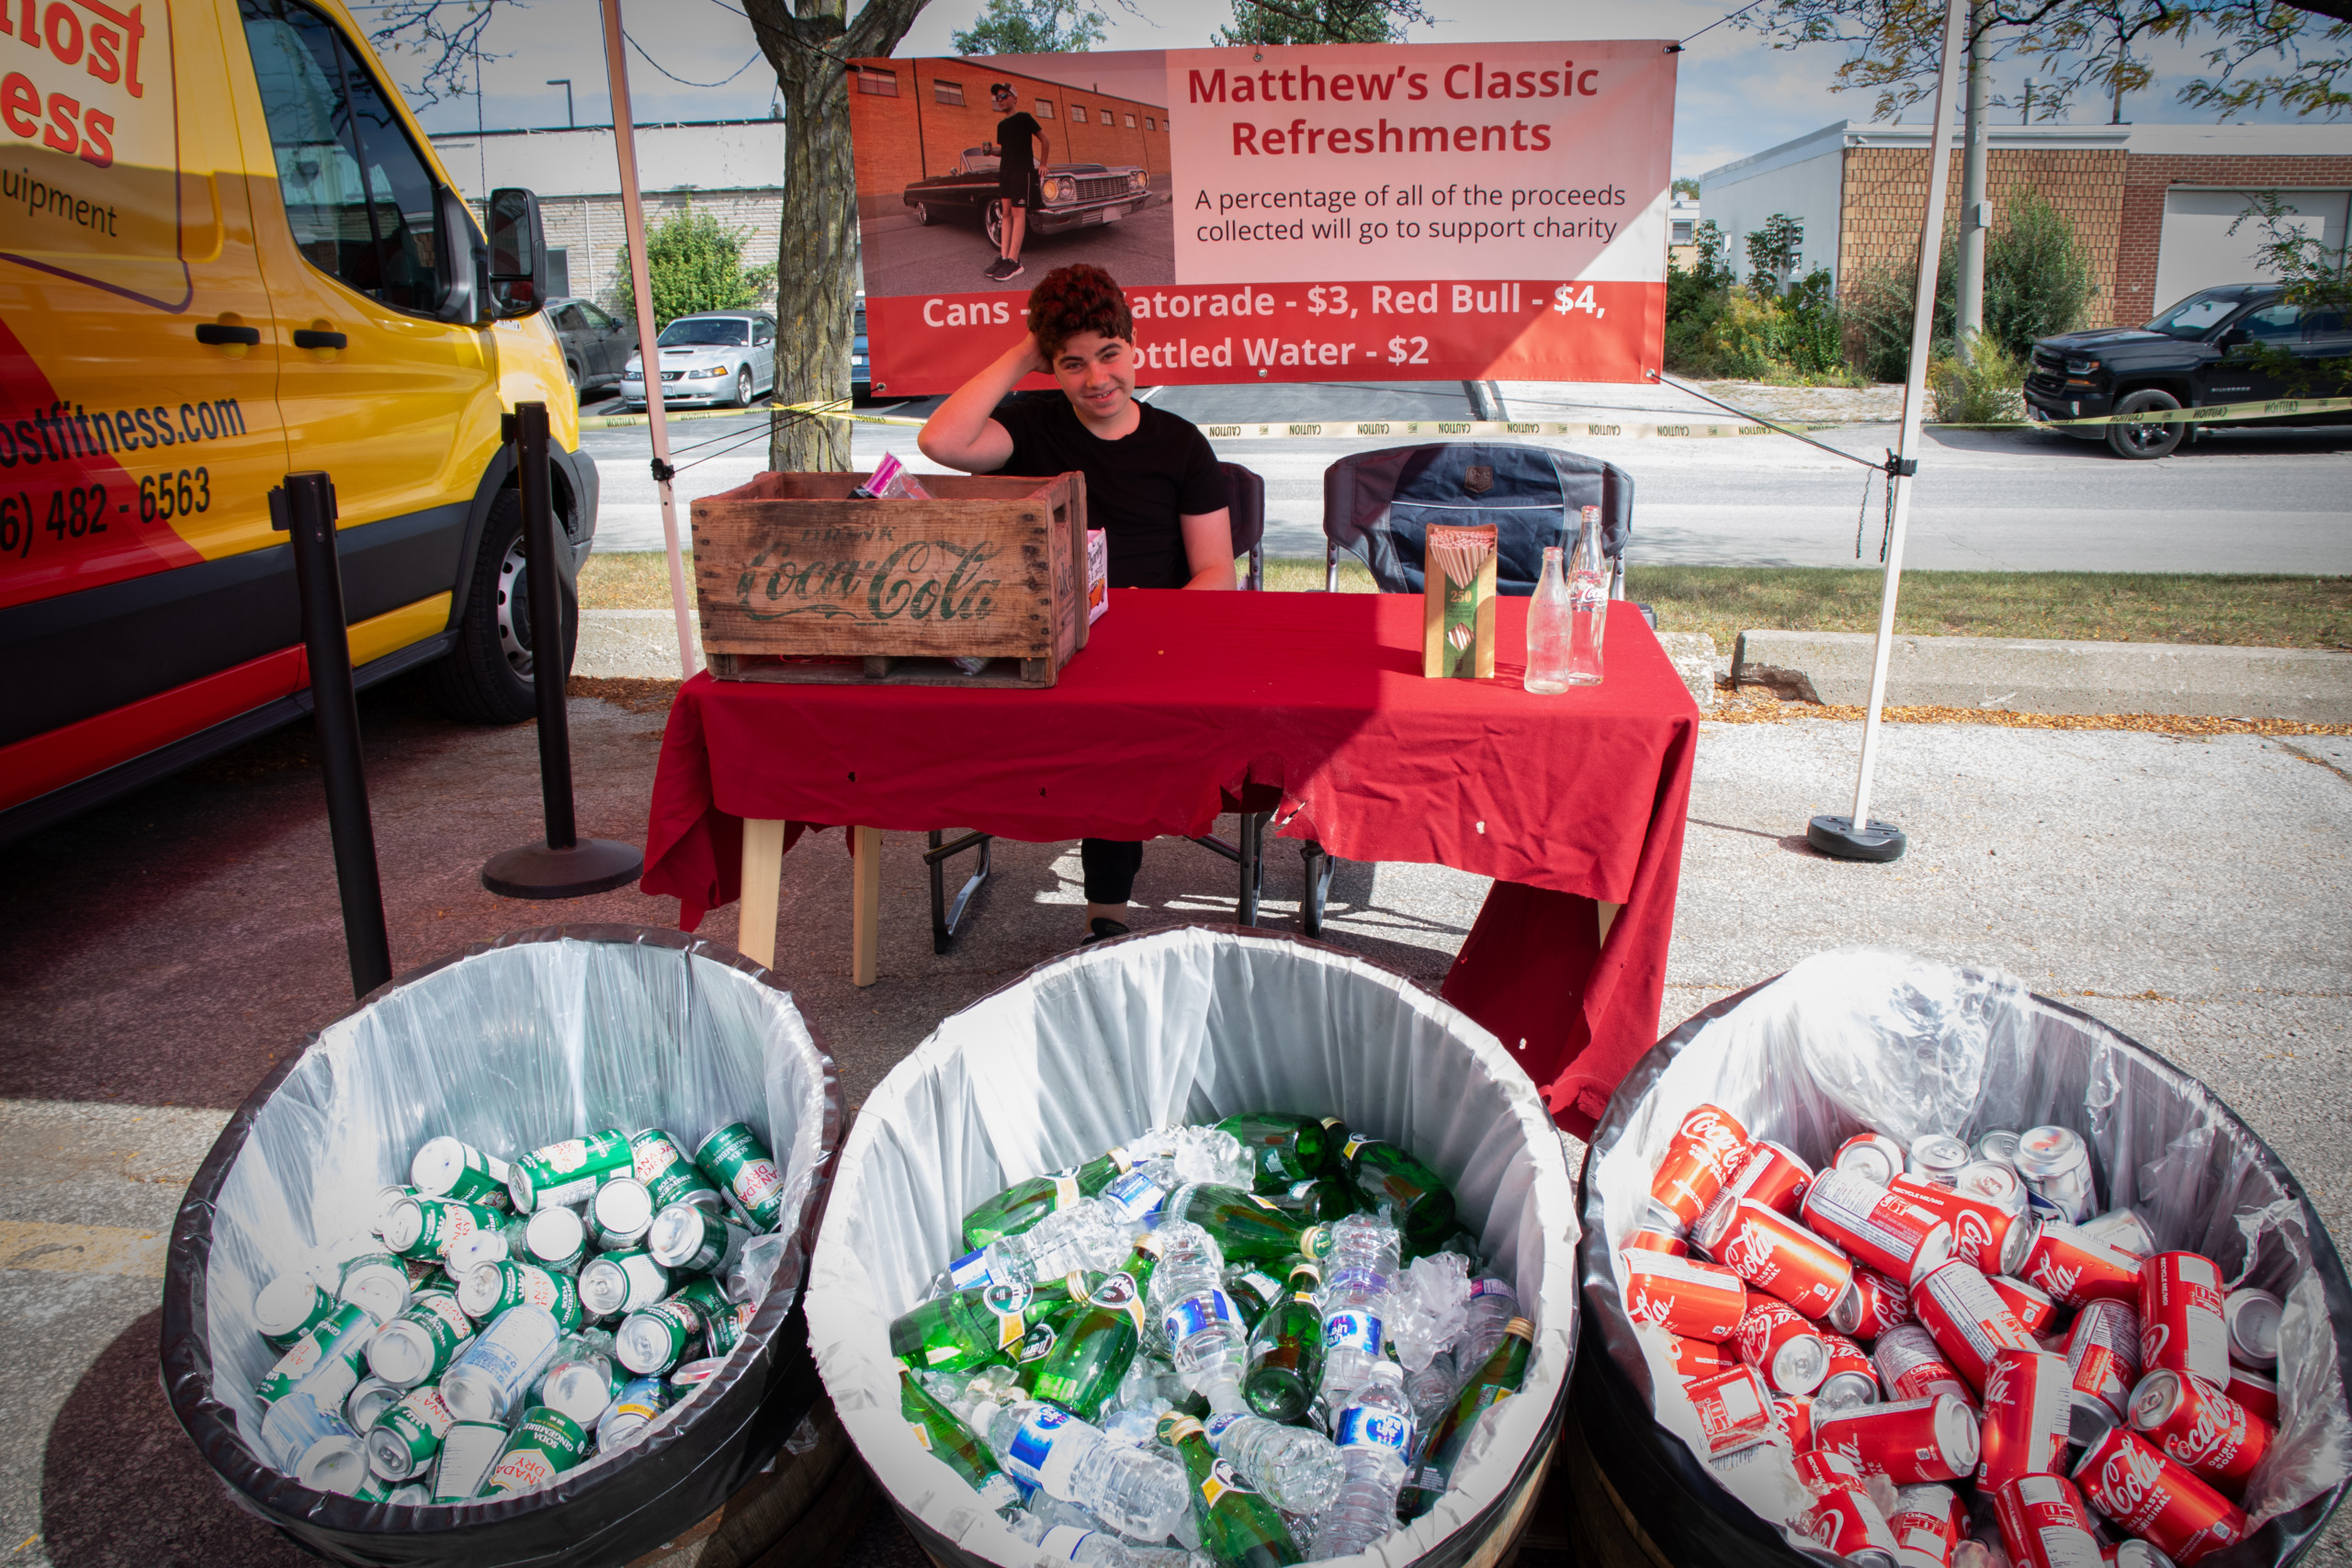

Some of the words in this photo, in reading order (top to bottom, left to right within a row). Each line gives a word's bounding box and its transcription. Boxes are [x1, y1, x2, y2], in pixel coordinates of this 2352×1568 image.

[1443, 61, 1599, 100] Classic
[1232, 118, 1552, 156] Refreshments
[3, 167, 117, 237] uipment
[1195, 189, 1212, 209] A
[1219, 186, 1356, 214] percentage
[1364, 184, 1390, 208] of
[1396, 184, 1422, 207] all
[1430, 184, 1457, 206] of
[1463, 184, 1503, 206] the
[1510, 184, 1625, 210] proceeds
[1196, 219, 1304, 242] collected
[1312, 218, 1351, 240] will
[1359, 224, 1388, 244] go
[1396, 220, 1420, 239] to
[1429, 220, 1525, 244] support
[1532, 216, 1617, 244] charity
[1125, 287, 1275, 319] atorade
[1307, 285, 1358, 319] $3,
[1372, 284, 1438, 313] Red
[1452, 283, 1521, 313] Bull
[1554, 284, 1606, 319] $4,
[922, 299, 1010, 328] Cans
[1133, 338, 1232, 369] ottled
[1243, 337, 1356, 366] Water
[1388, 335, 1429, 367] $2
[1209, 425, 1241, 437] CAUTION
[1289, 423, 1321, 435] CAUTION
[1357, 423, 1390, 434] CAUTION
[1438, 423, 1471, 434] CAUTION
[1507, 423, 1540, 434] CAUTION
[1588, 423, 1621, 435] CAUTION
[1657, 424, 1690, 437] CAUTION
[46, 484, 107, 540] 482
[140, 467, 210, 523] 6563
[737, 540, 1001, 621] Coca-Cola
[1450, 590, 1472, 603] 250
[713, 1135, 752, 1166] GINGEMBRE
[727, 1145, 748, 1162] SODA
[644, 1157, 664, 1177] DRY
[745, 1164, 769, 1182] DRY
[656, 1174, 694, 1209] GINGEMBRE
[657, 1175, 677, 1192] SODA
[1892, 1185, 1919, 1198] RECYCLE
[1330, 1322, 1347, 1335] Life
[1909, 1362, 1933, 1375] Coke
[523, 1423, 574, 1452] GINGEMBRE
[533, 1432, 559, 1449] SODA
[496, 1465, 540, 1484] NADA
[2138, 1484, 2165, 1515] TASTE
[2135, 1492, 2172, 1533] ORIGINAL
